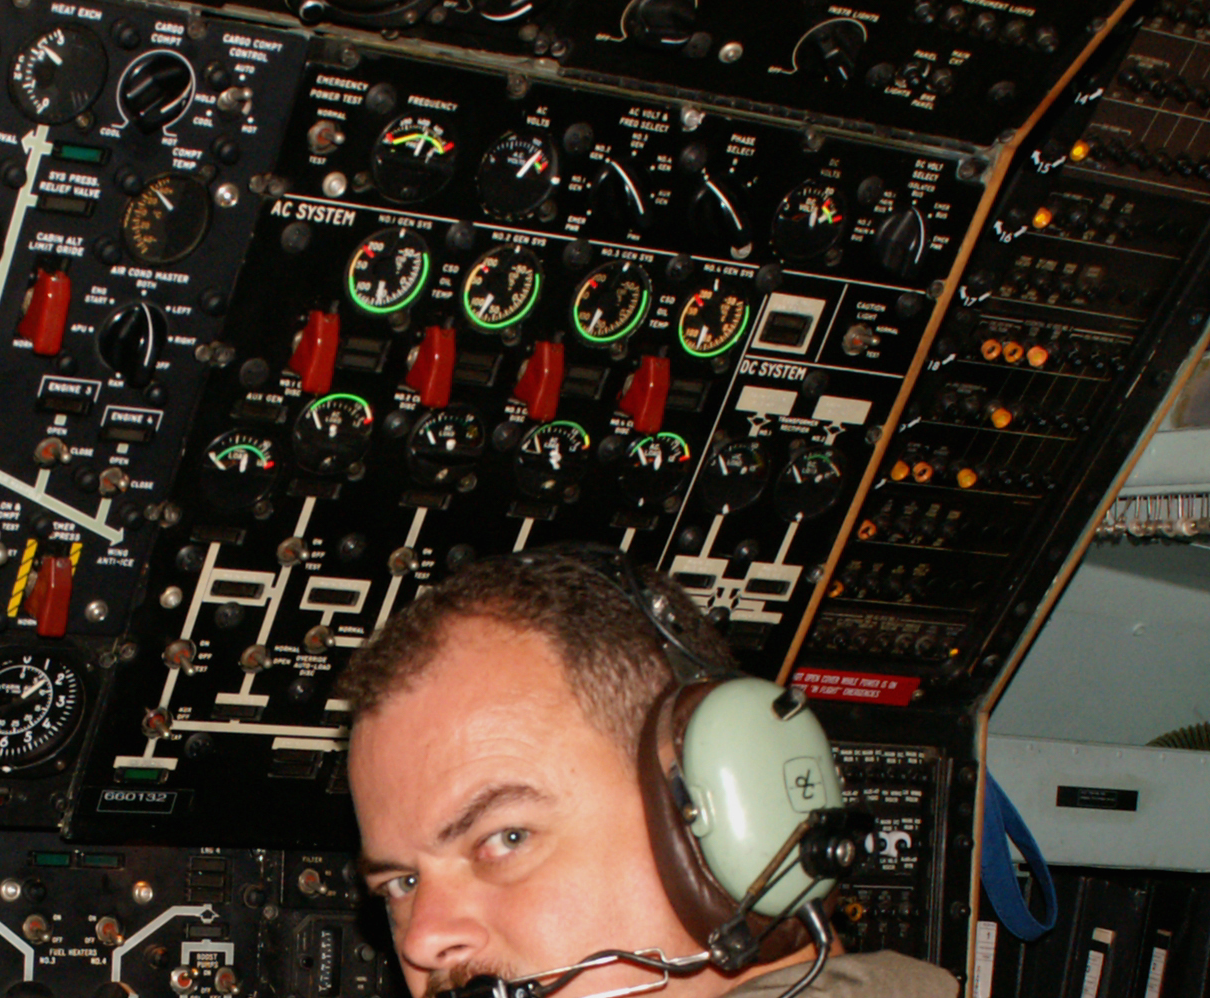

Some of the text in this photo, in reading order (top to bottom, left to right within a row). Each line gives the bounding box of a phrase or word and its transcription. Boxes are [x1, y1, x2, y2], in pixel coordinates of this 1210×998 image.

[52, 3, 102, 20] HEAT EXCH
[223, 34, 282, 51] CARGO COMPT
[229, 47, 268, 62] CONTROL
[316, 75, 368, 91] EMERGENCY
[310, 89, 362, 105] POWER TEST
[408, 96, 458, 112] FREQUENCY
[643, 120, 669, 132] SELECT
[172, 147, 202, 159] COMPT
[172, 159, 197, 170] TEMP
[1038, 162, 1050, 174] 15
[272, 201, 356, 226] AC SYSTEM
[36, 232, 83, 246] CABIN ALT
[1000, 232, 1012, 243] 16
[28, 240, 55, 253] LIMIT
[110, 266, 189, 284] AIR COND MASTER
[740, 360, 807, 381] DC SYSTEM
[48, 382, 82, 394] ENGINE
